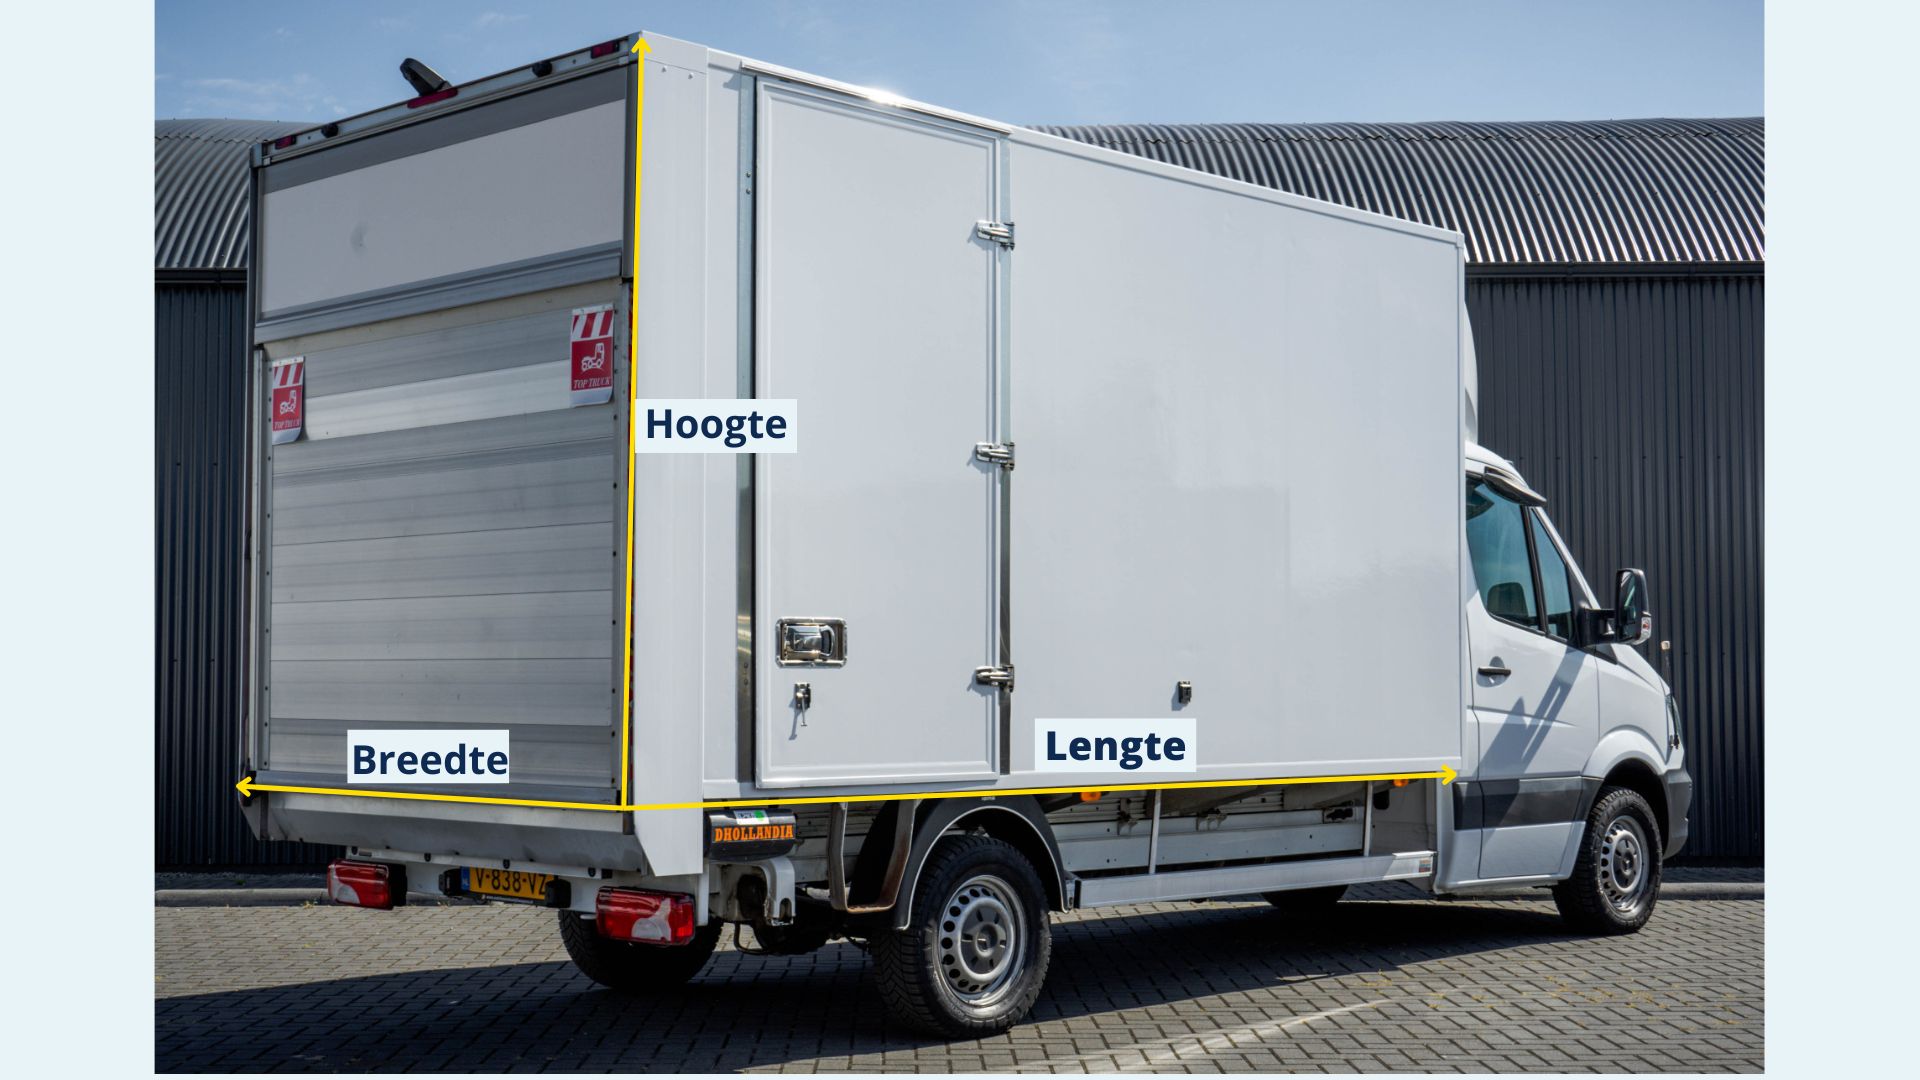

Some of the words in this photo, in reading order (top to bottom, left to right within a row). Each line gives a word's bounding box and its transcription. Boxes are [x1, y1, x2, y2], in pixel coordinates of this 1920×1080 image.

[574, 379, 588, 389] TOP
[588, 376, 611, 387] TRUCK
[714, 824, 794, 843] DHOLLANDIA
